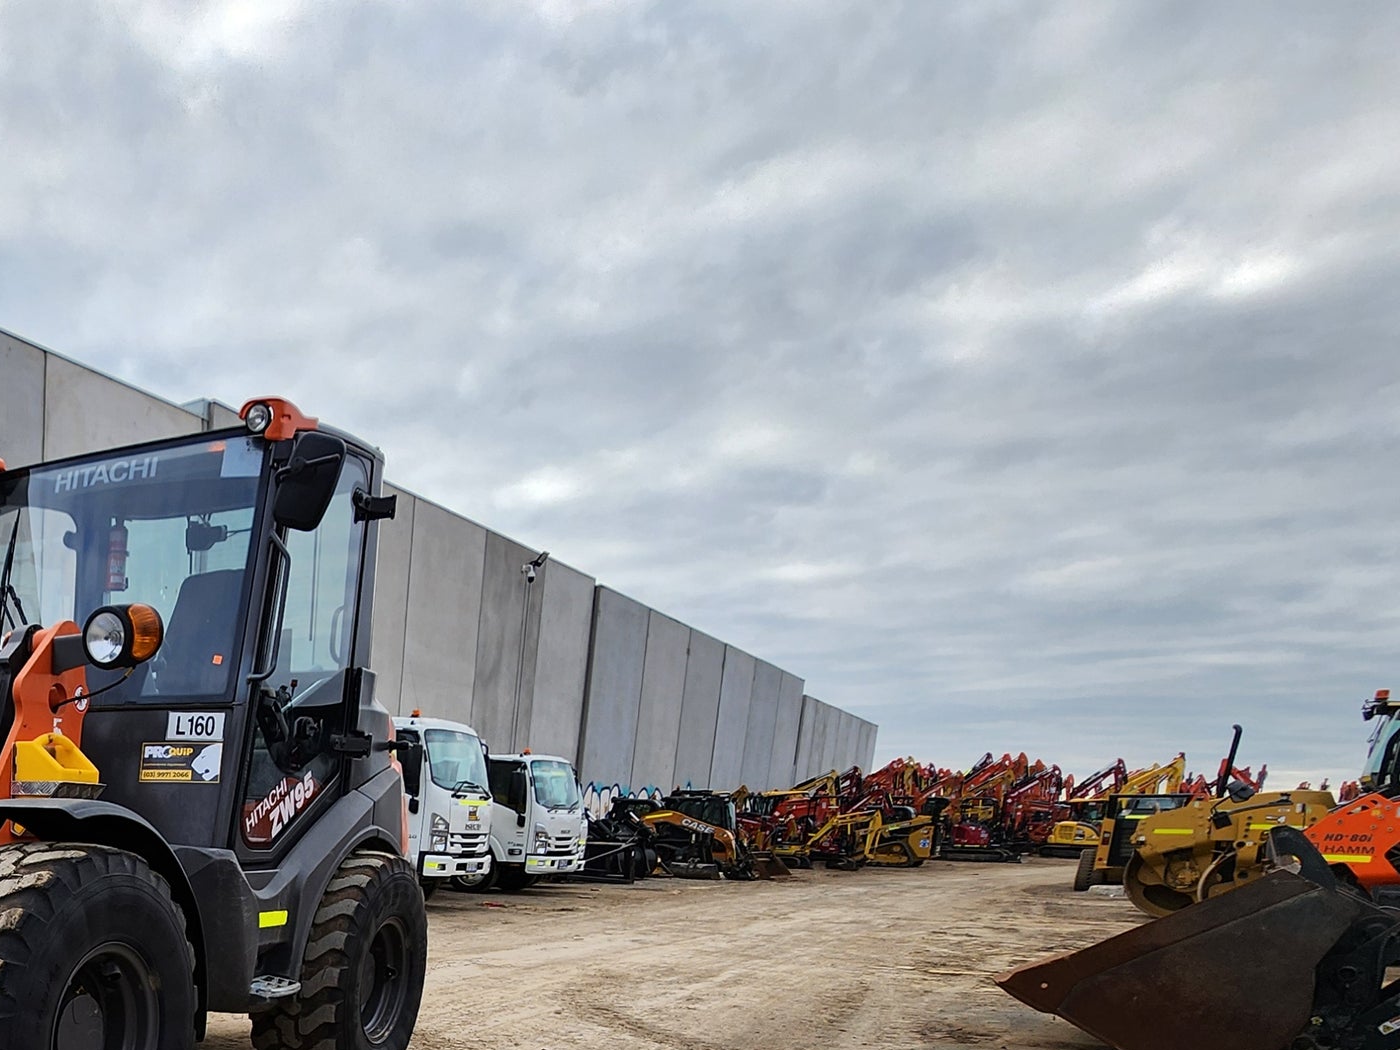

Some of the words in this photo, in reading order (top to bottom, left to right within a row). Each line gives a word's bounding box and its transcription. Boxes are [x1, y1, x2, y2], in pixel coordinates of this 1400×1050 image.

[55, 457, 159, 494] HITACHI
[176, 716, 215, 736] L160
[245, 777, 288, 833] HITACHI
[269, 770, 314, 838] ZW95
[681, 818, 715, 834] CASE
[1324, 845, 1375, 854] HAMM
